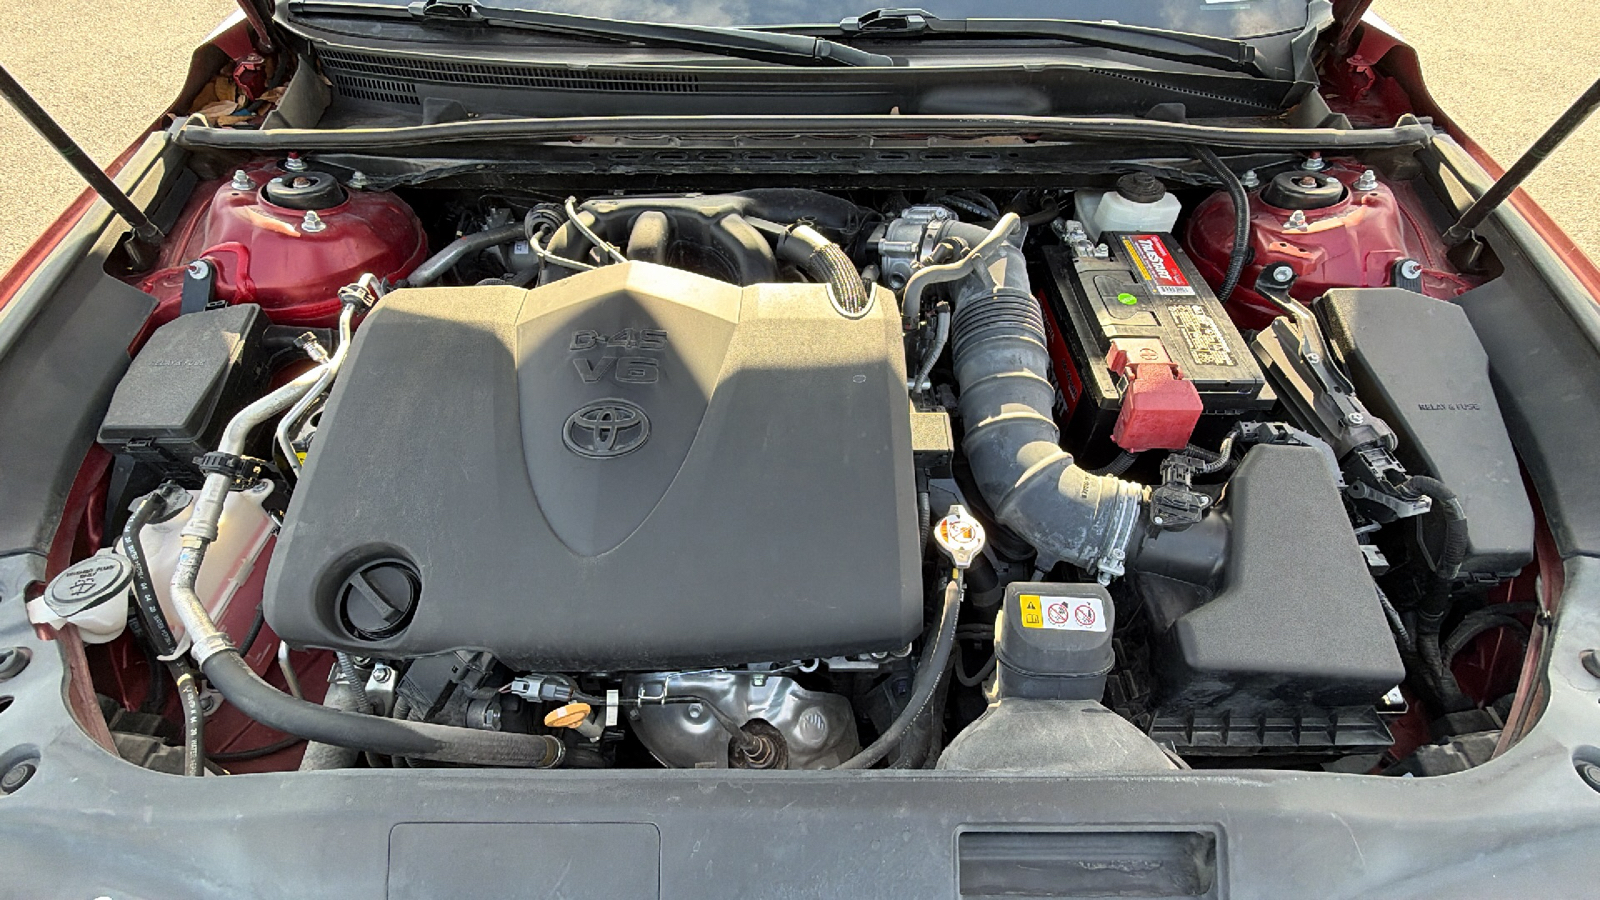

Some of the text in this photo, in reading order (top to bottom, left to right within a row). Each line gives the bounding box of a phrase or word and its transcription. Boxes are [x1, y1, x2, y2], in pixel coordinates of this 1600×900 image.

[573, 356, 660, 384] V6
[1418, 403, 1446, 411] RELAY
[1456, 403, 1481, 411] FUSE
